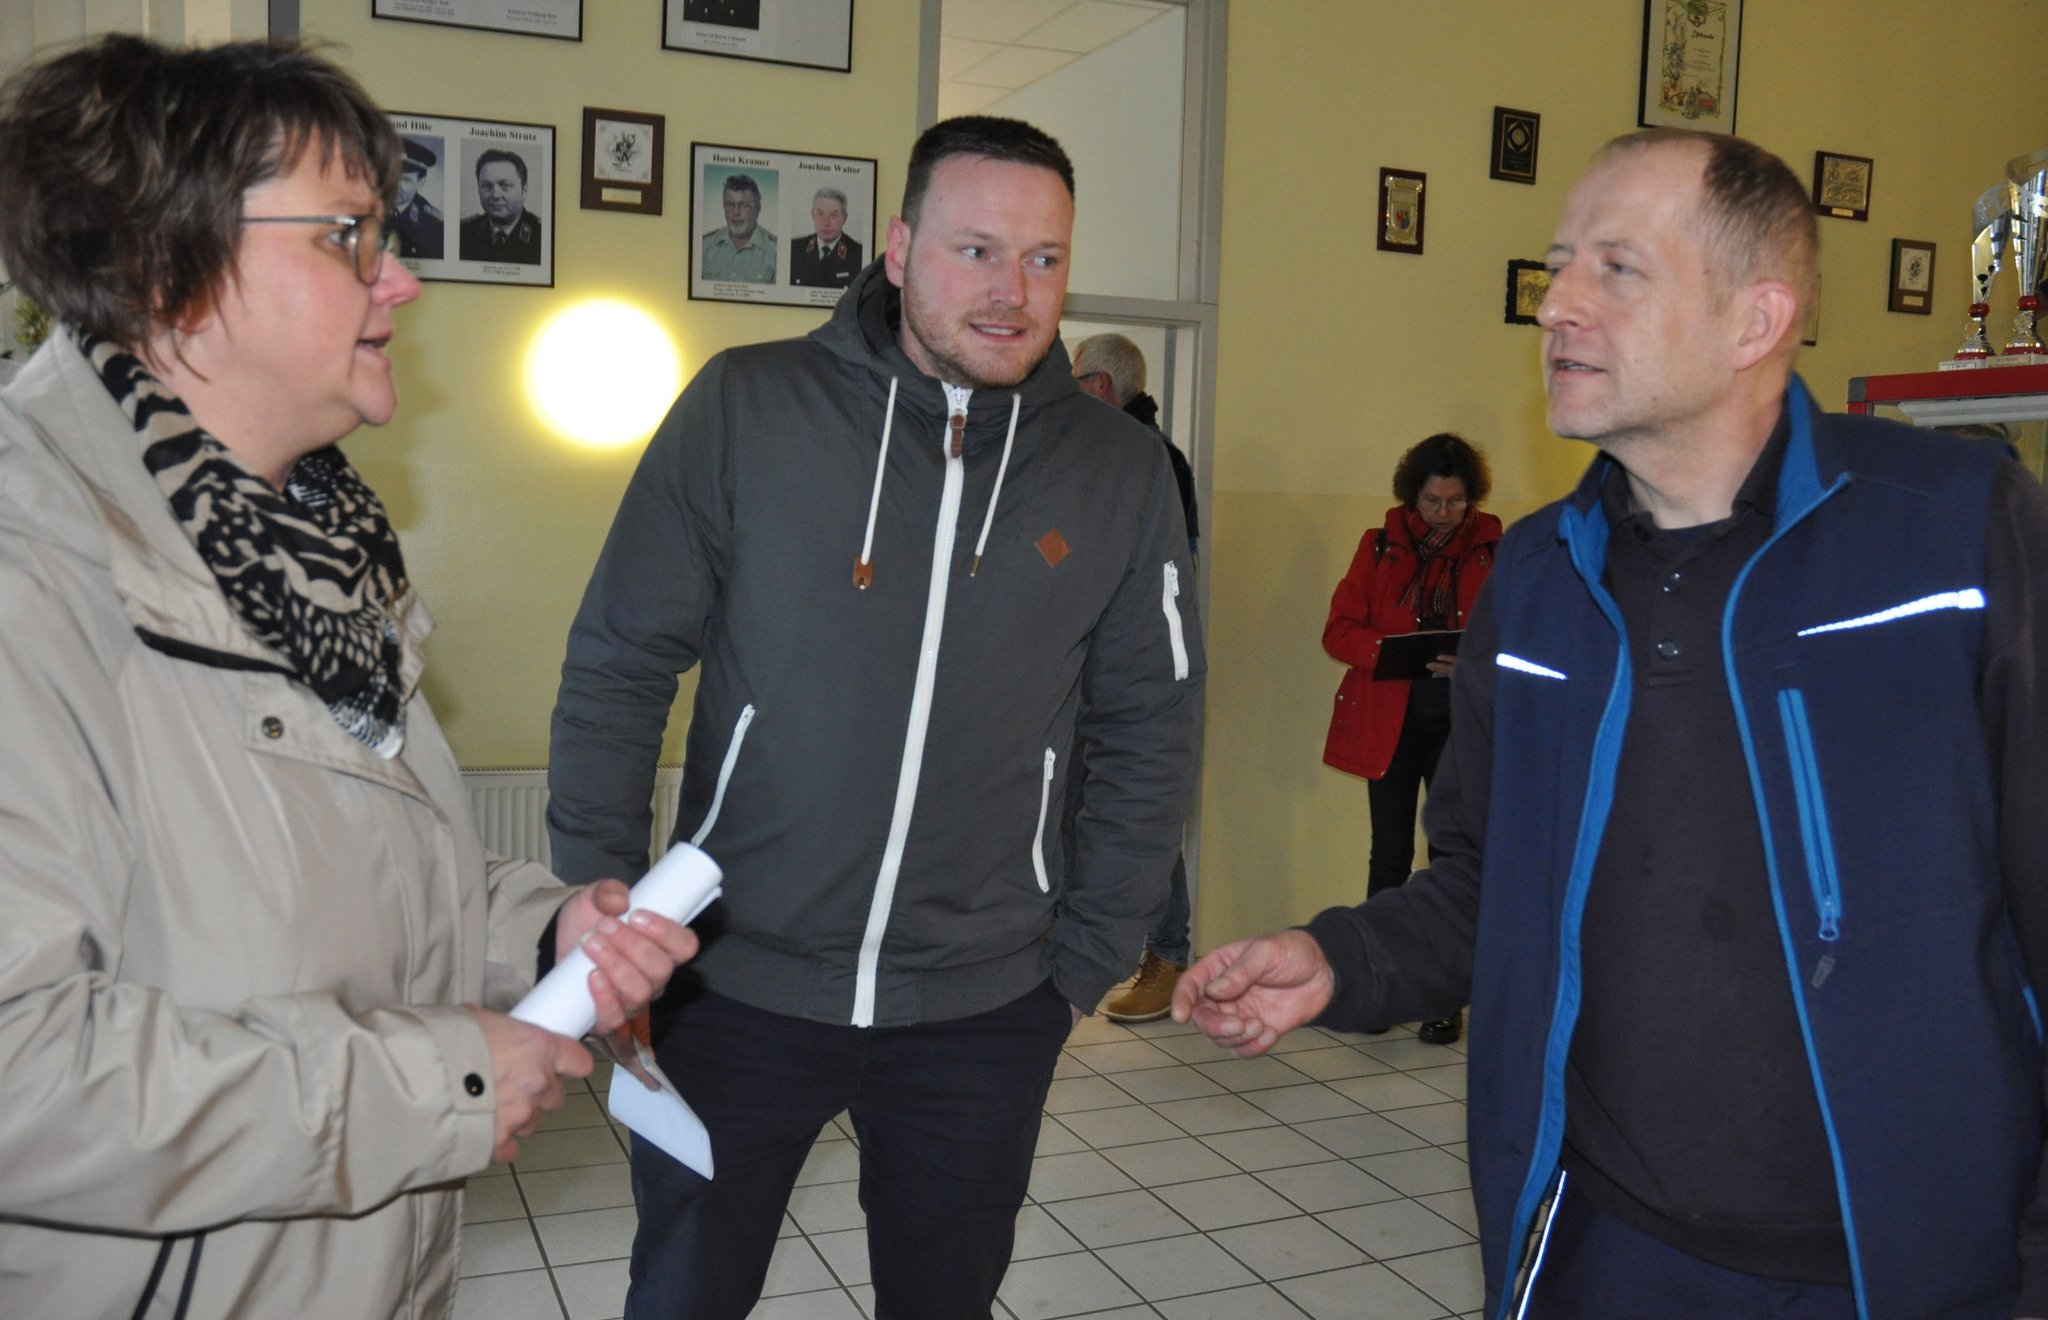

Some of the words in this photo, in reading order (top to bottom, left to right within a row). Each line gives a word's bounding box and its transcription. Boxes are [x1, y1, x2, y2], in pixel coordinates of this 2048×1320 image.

[411, 119, 433, 131] Hille
[469, 127, 507, 138] Joachim
[509, 131, 537, 141] Strutz
[713, 153, 736, 164] Horst
[738, 156, 771, 167] Kramer
[798, 161, 832, 172] Joachim
[834, 164, 861, 175] Walter
